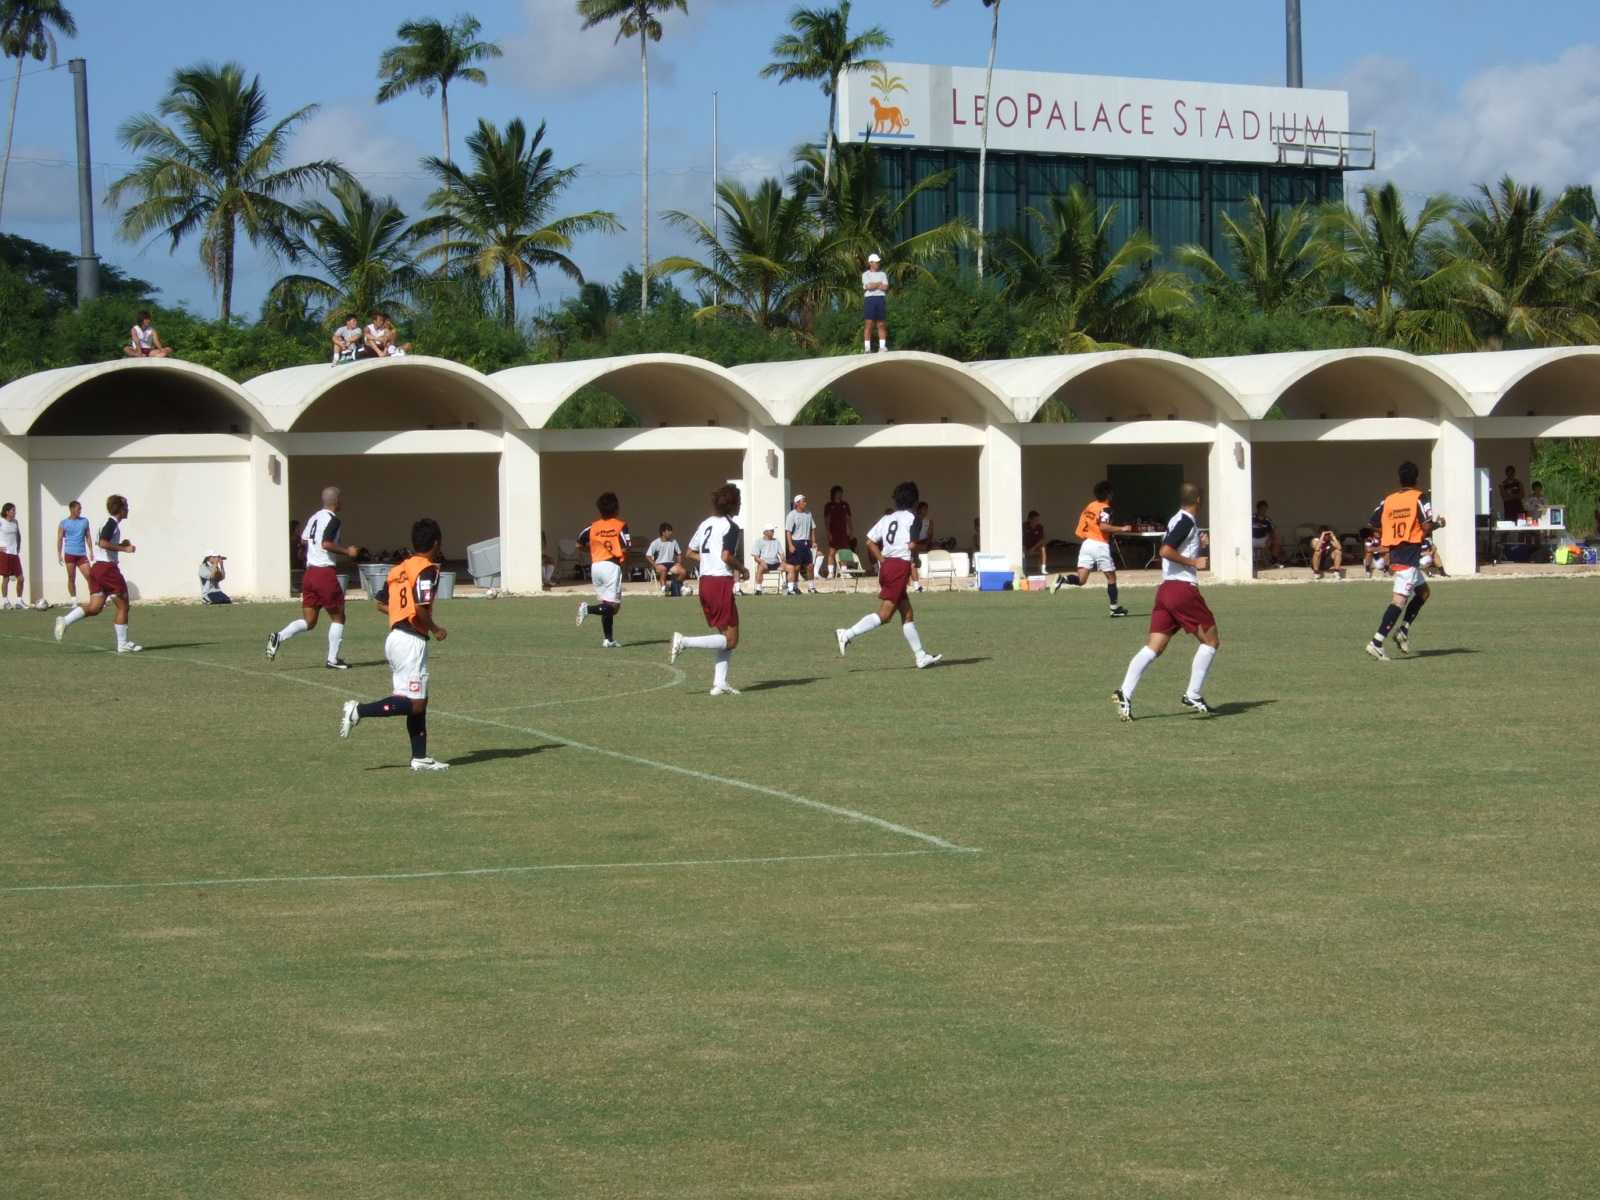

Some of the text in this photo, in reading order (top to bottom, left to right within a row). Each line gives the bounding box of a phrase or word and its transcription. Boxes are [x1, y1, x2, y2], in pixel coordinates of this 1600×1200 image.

[952, 88, 1327, 144] LEOPALACE STADIUM
[309, 519, 318, 545] 4
[701, 525, 713, 554] 2
[886, 520, 898, 545] 8
[1391, 521, 1407, 538] 10
[400, 586, 408, 609] 8
